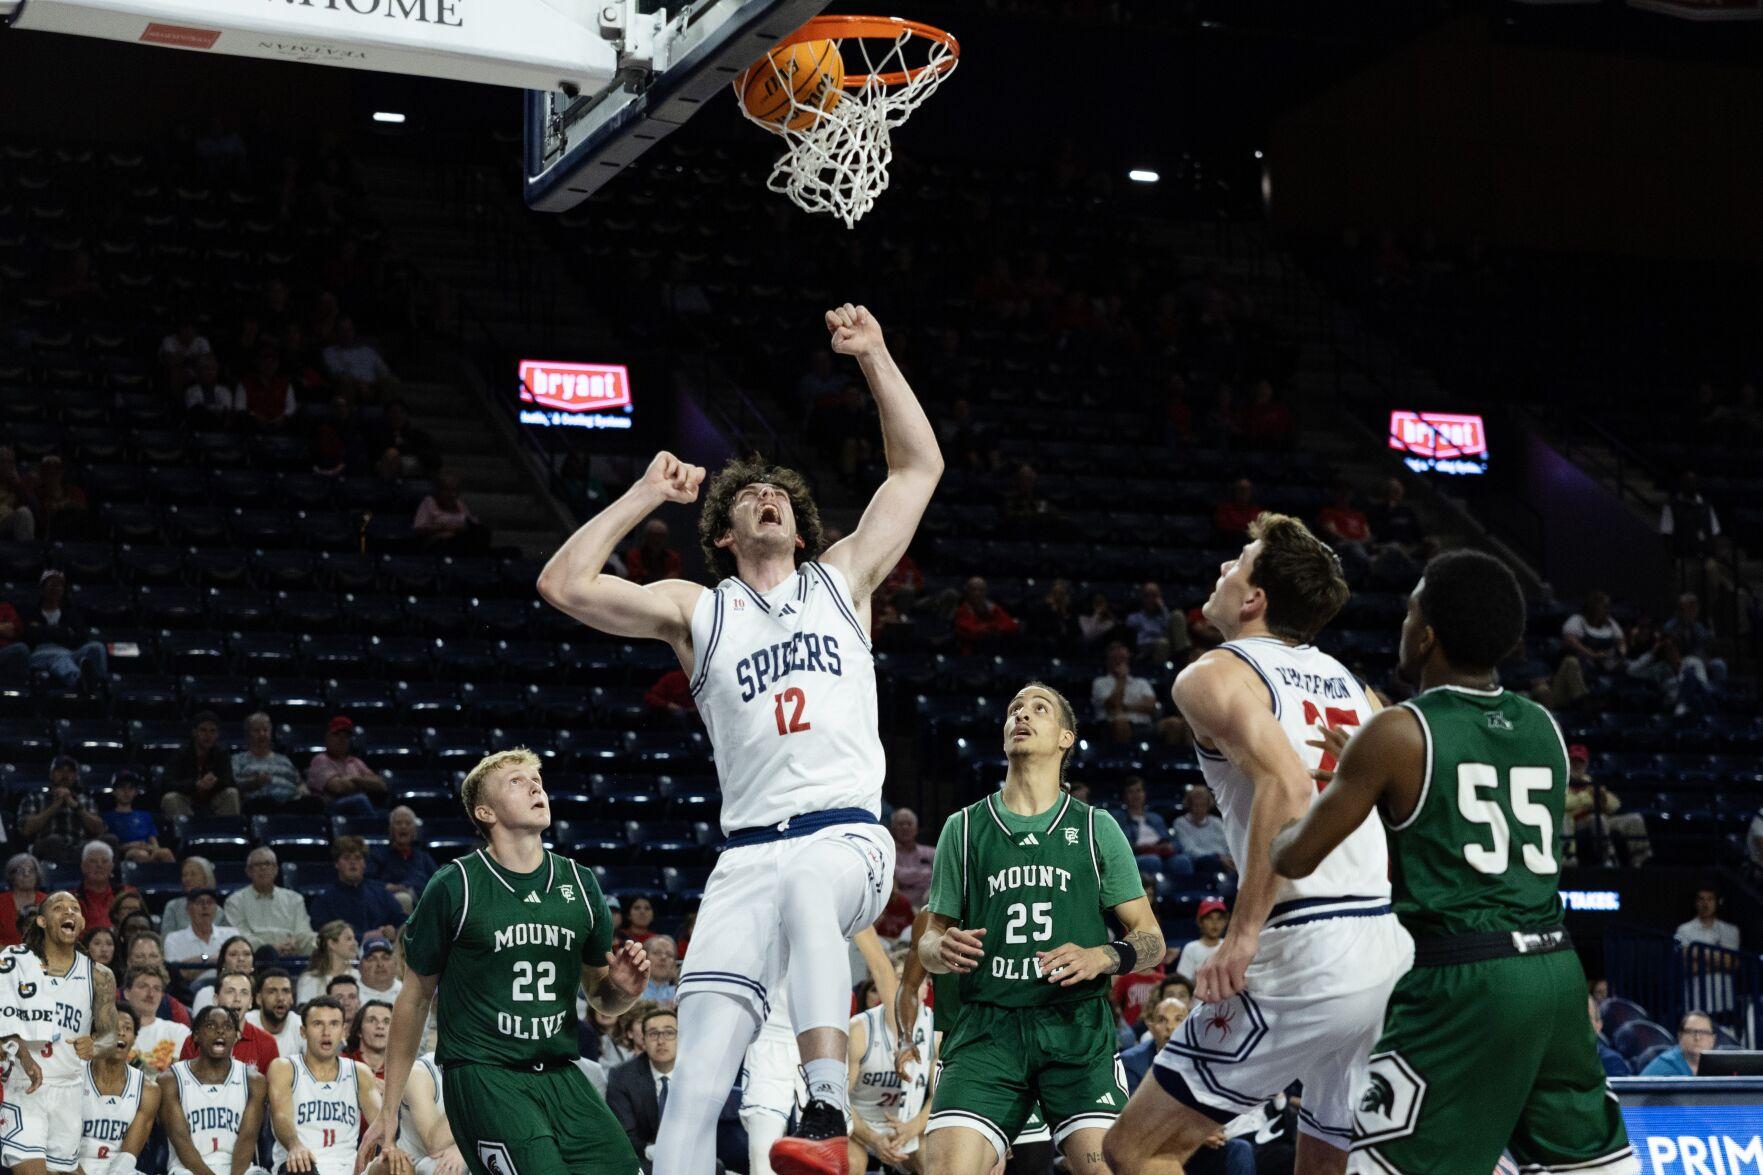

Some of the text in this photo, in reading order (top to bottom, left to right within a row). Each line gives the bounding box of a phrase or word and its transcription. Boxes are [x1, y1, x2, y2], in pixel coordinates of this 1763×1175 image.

[297, 0, 463, 27] OME
[774, 687, 812, 736] 12
[1457, 763, 1558, 874] 55
[987, 865, 1071, 898] MOUNT
[1005, 902, 1053, 944] 25
[494, 923, 575, 953] MOUNT
[512, 961, 557, 1001] 22
[992, 956, 1064, 980] OLIV
[498, 1010, 567, 1040] OLIVE
[863, 1071, 902, 1089] SPID
[297, 1100, 356, 1127] SPIDERS
[82, 1119, 129, 1141] PIDER
[322, 1128, 336, 1148] 11
[211, 1137, 218, 1153] 1
